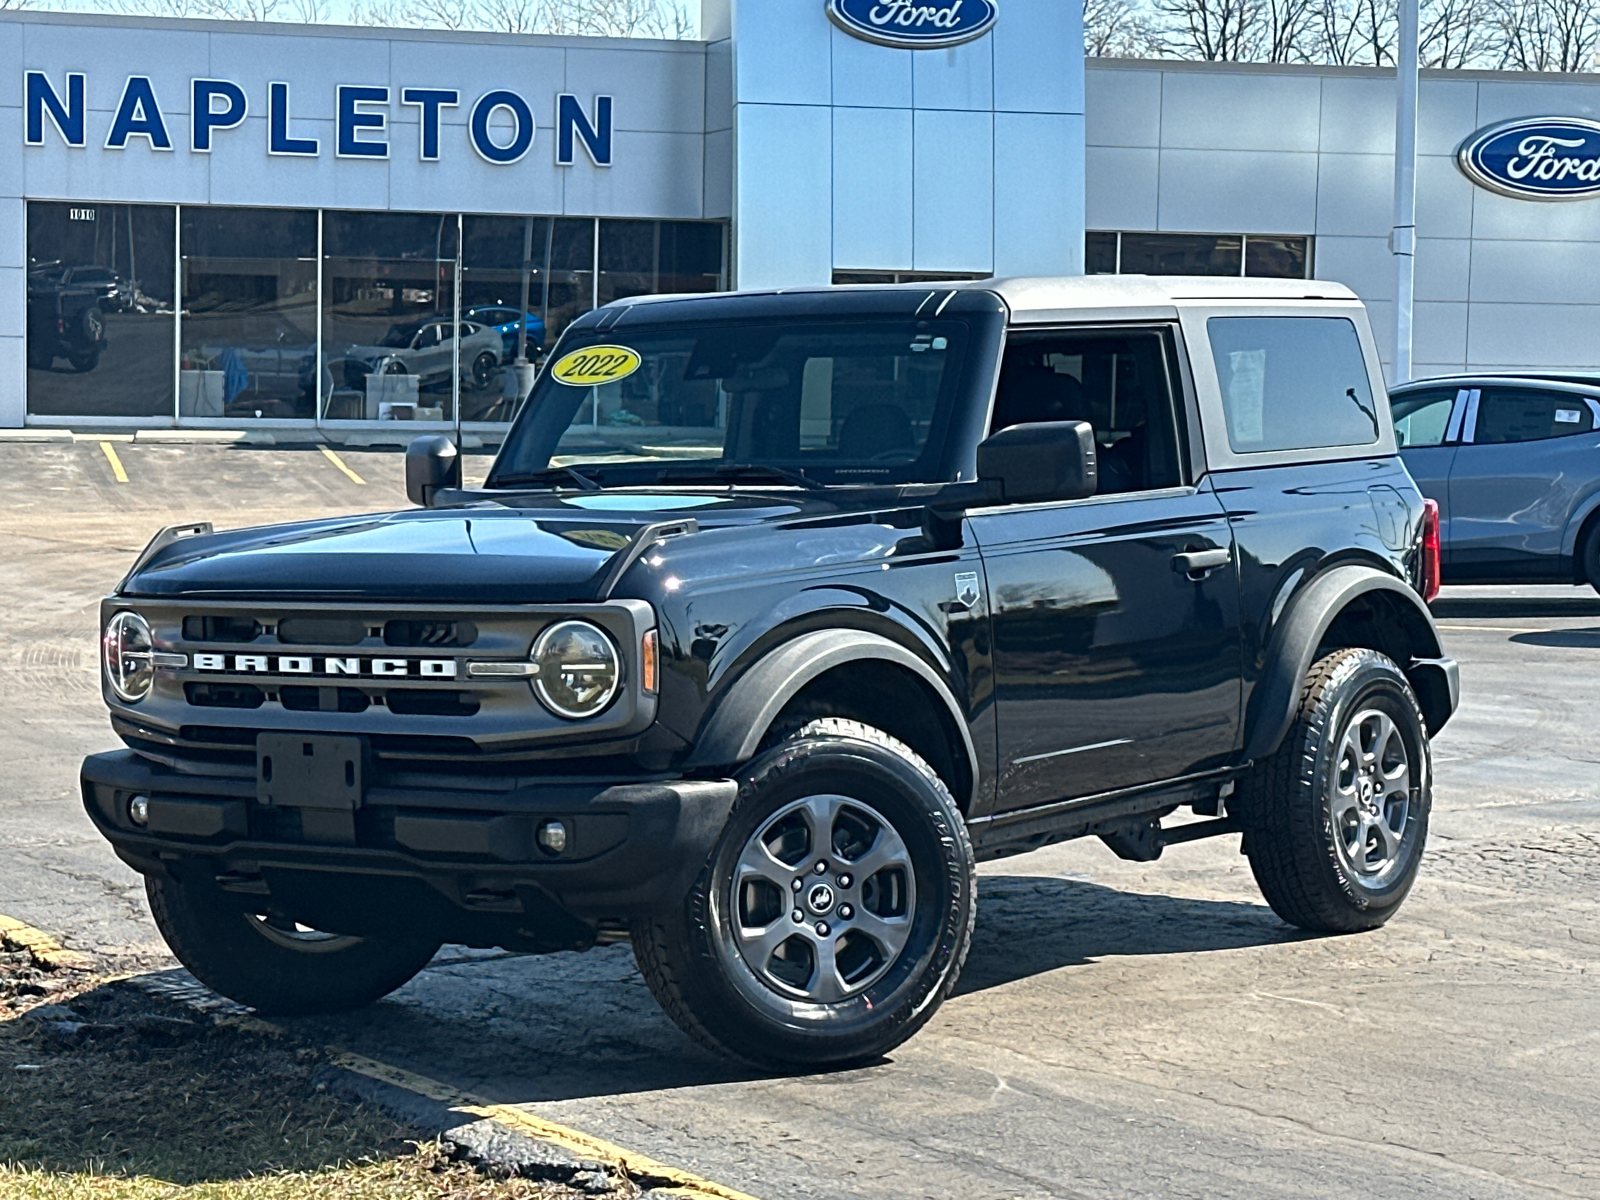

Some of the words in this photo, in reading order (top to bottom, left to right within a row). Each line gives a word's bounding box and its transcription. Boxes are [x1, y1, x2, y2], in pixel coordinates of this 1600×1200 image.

[869, 0, 963, 28] Ford
[24, 70, 613, 166] NAPLETON
[1506, 135, 1600, 181] Ford
[70, 208, 95, 220] 1010
[561, 354, 629, 377] 2022
[193, 653, 457, 677] BRONCO
